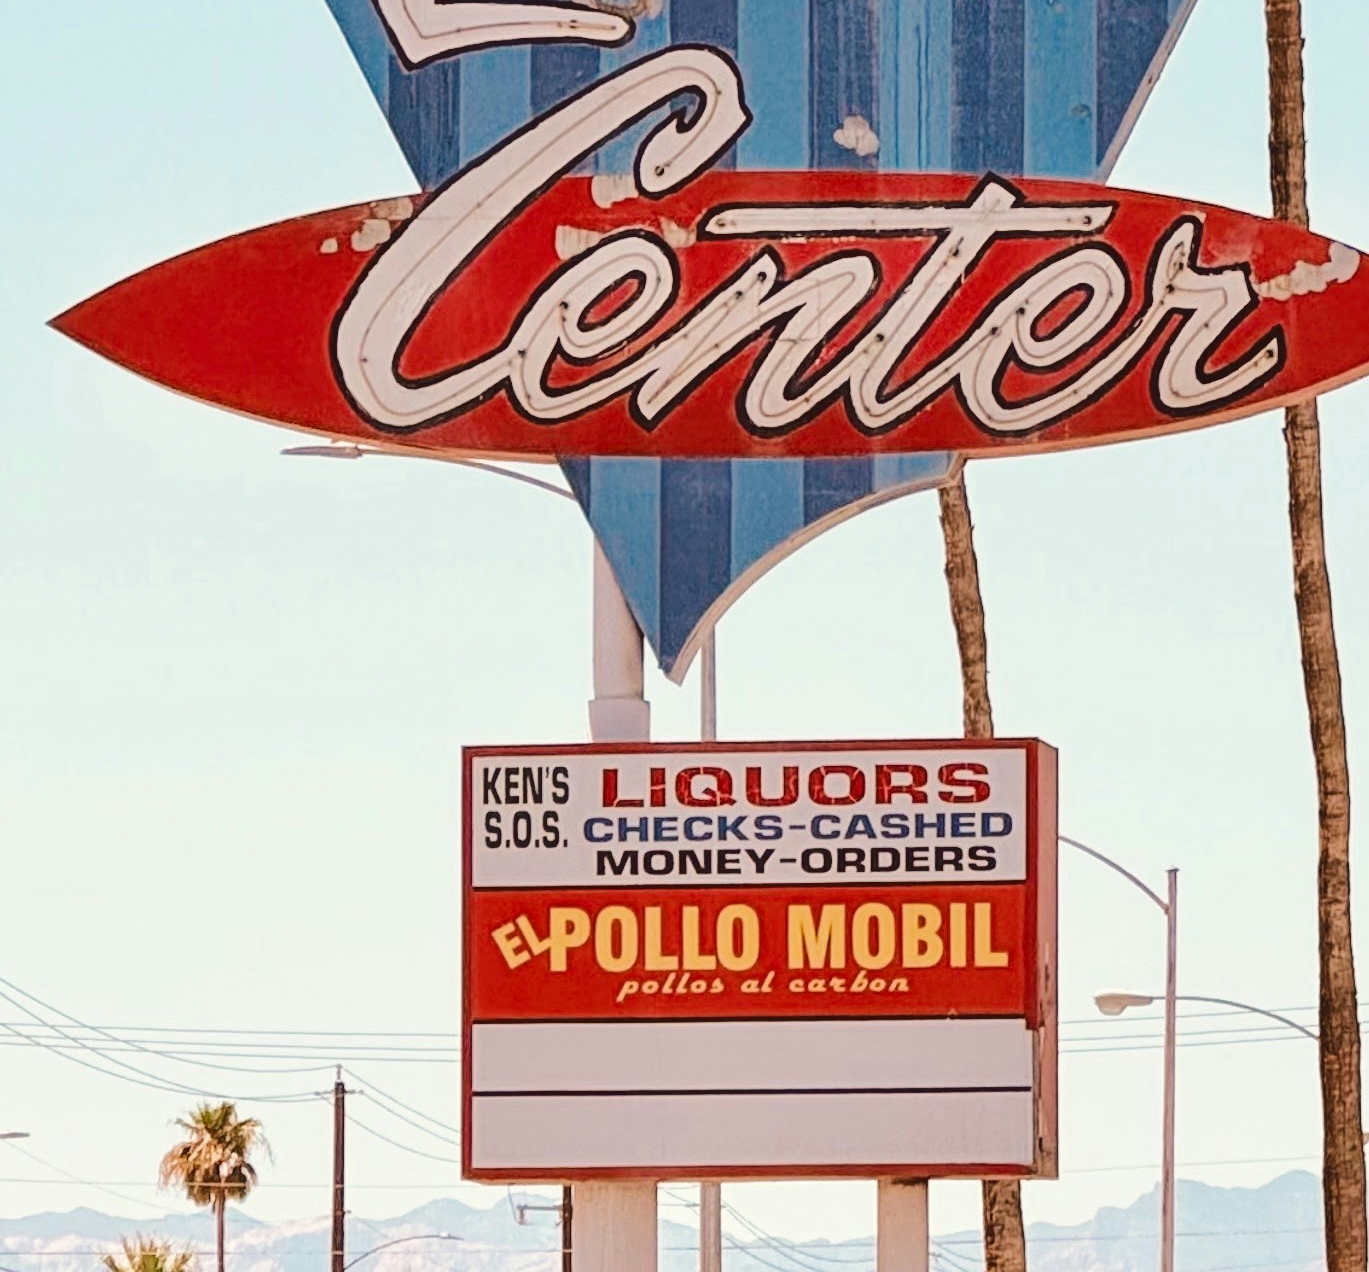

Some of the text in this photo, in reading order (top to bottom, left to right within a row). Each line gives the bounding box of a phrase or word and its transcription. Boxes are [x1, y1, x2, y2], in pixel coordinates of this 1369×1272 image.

[331, 43, 1289, 436] Center
[482, 766, 570, 805] KEN'S
[602, 762, 991, 808] LIQUORS
[484, 810, 568, 849] S.O.S.
[583, 812, 1013, 843] CHECKS-CASHED
[596, 845, 997, 876] MONEY-ORDERS
[491, 902, 1008, 972] EL POLLO MOBIL
[616, 970, 909, 1003] pollos al carbon
